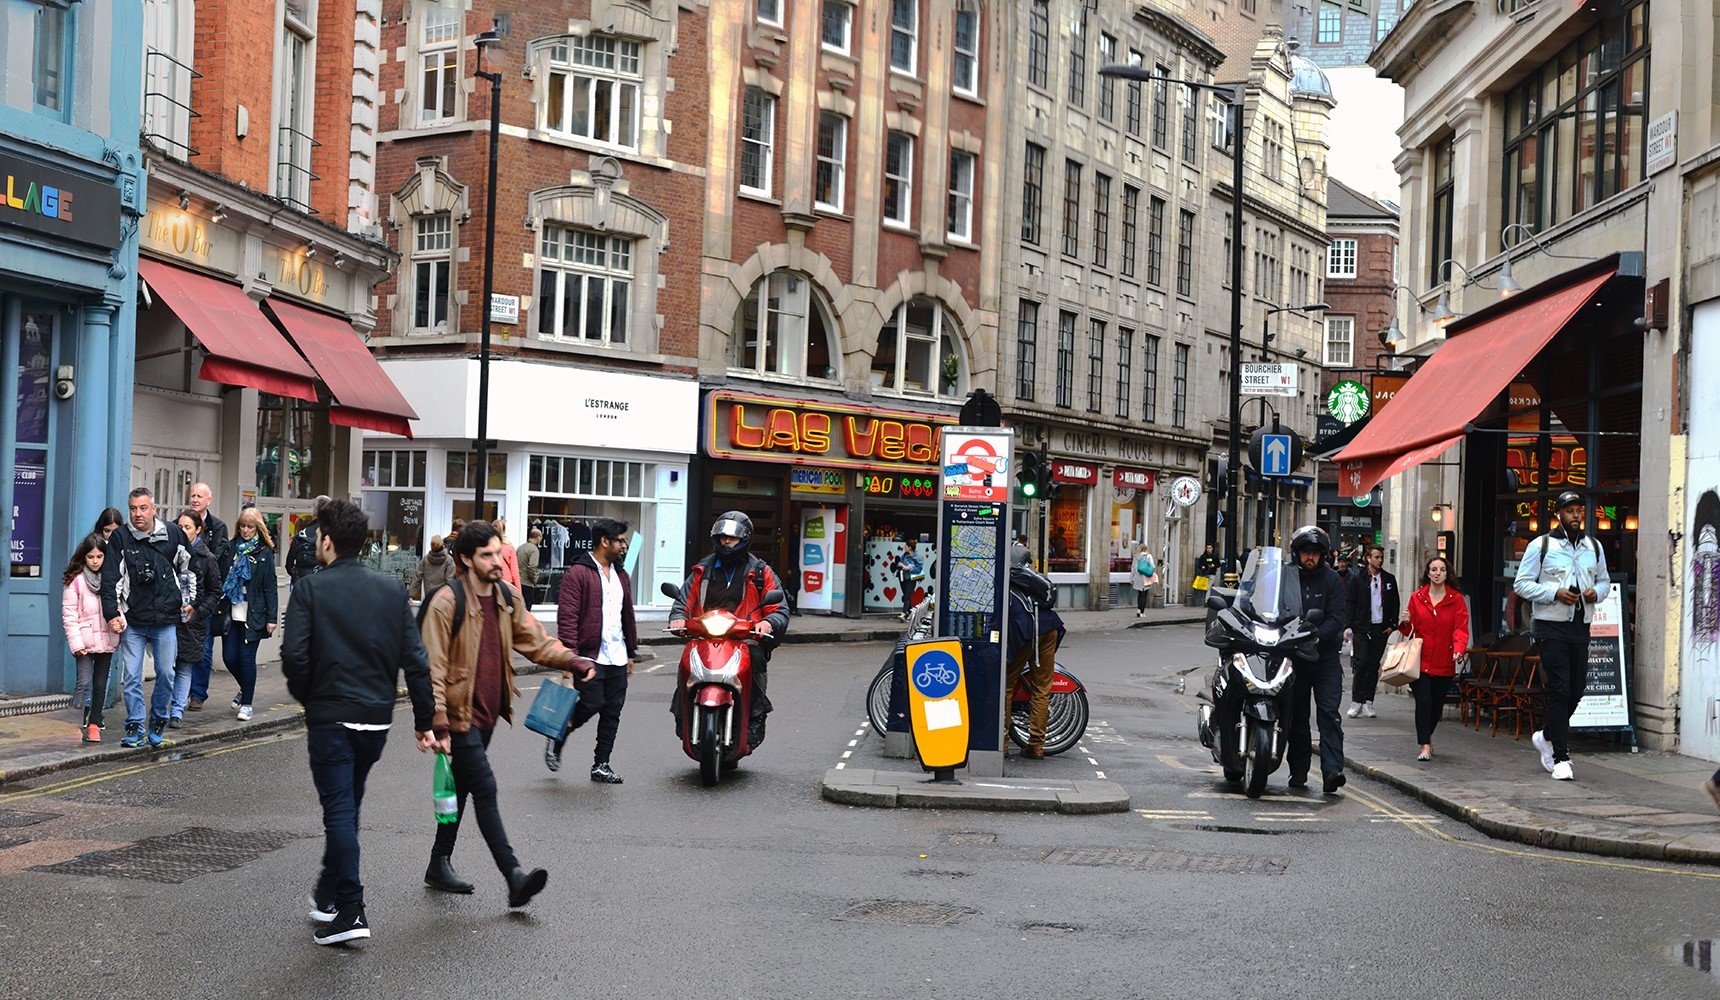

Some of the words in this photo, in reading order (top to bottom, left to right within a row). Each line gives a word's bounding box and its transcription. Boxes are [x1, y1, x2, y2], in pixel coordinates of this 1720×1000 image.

[1650, 117, 1671, 140] WARDOUR
[1649, 137, 1664, 157] STREET
[147, 210, 169, 243] The
[191, 226, 214, 258] Bar
[279, 258, 296, 286] The
[299, 260, 312, 295] O
[313, 270, 330, 297] Bar
[491, 305, 507, 313] TREET
[1245, 364, 1282, 373] BOURCHIER
[1244, 375, 1270, 385] STREET
[1281, 376, 1290, 385] W1
[585, 398, 629, 411] L'ESTRANGE
[730, 405, 831, 454] LAS
[1063, 432, 1107, 456] CINEMA
[1118, 438, 1153, 462] HOUSE
[737, 480, 748, 490] 89
[824, 471, 843, 486] POOL
[552, 540, 571, 549] YOU
[575, 540, 595, 549] NEE
